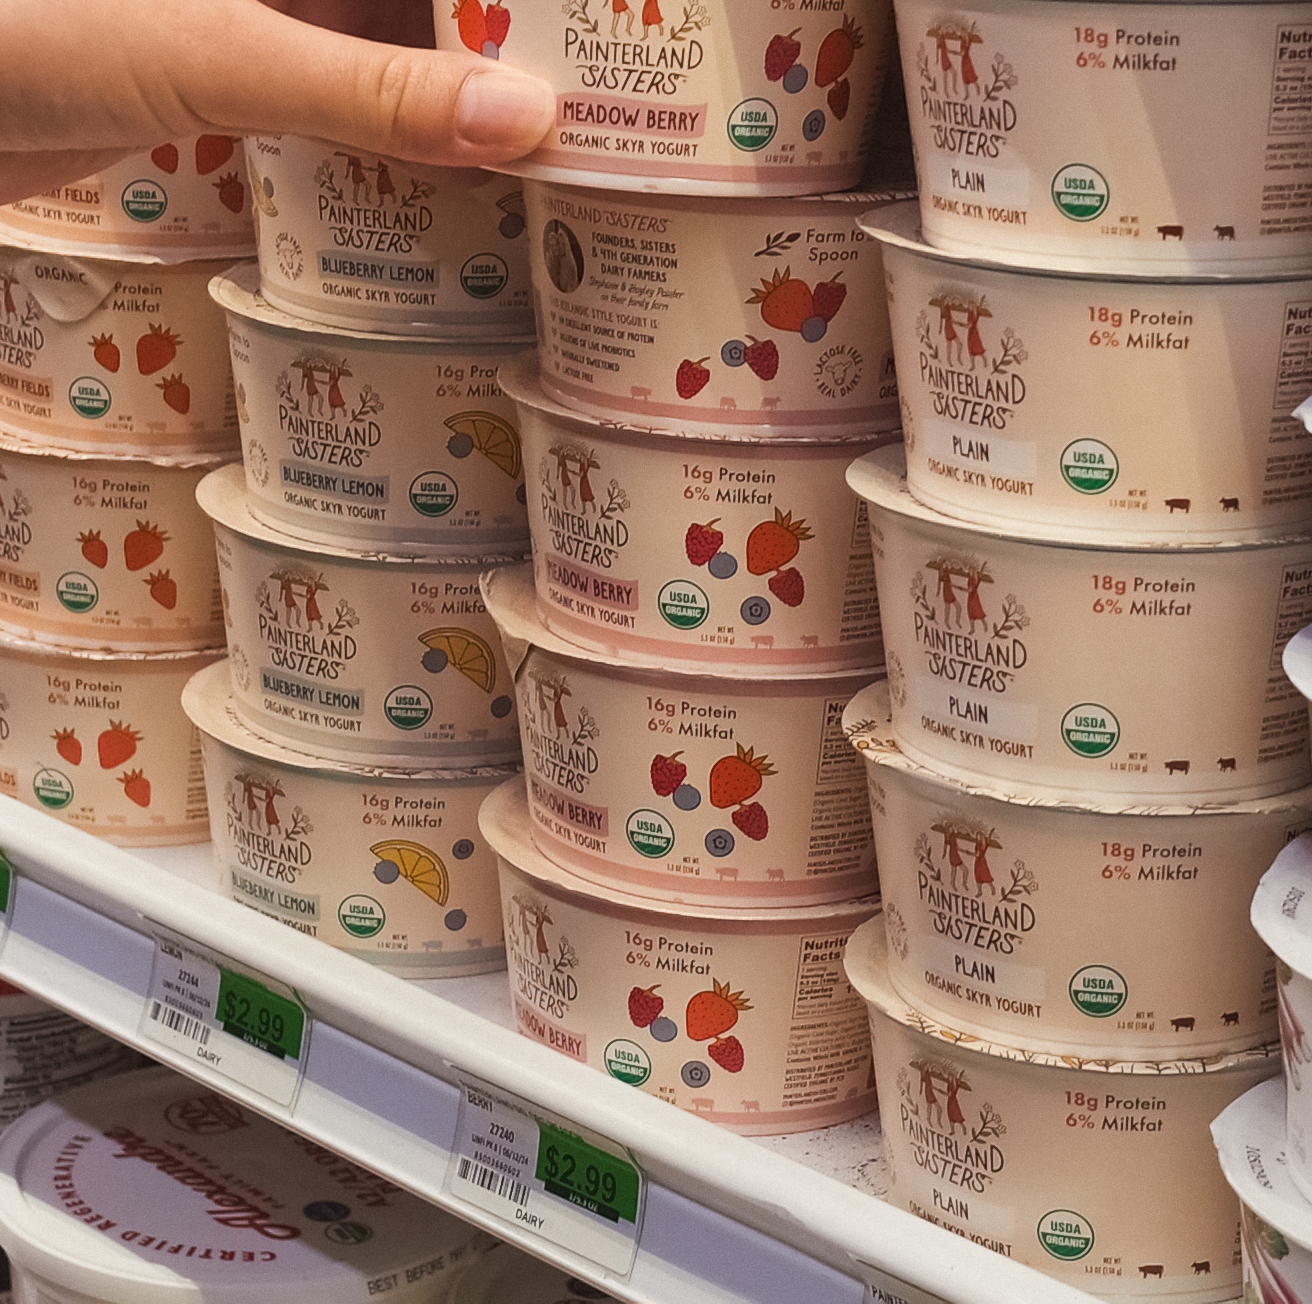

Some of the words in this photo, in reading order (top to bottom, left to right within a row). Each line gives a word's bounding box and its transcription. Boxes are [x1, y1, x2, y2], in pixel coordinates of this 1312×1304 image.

[563, 27, 704, 70] PAINTERLAND
[1074, 26, 1108, 49] 18g
[1116, 30, 1180, 47] Protein
[1076, 52, 1106, 70] 6%
[1112, 53, 1176, 72] Milkfat
[575, 65, 688, 95] SISTERS
[563, 100, 639, 128] MEADOW
[646, 107, 700, 132] BERRY
[741, 110, 768, 124] USDA
[560, 131, 610, 150] ORGANIC
[615, 137, 647, 154] SKYR
[652, 141, 698, 158] YOGURT
[951, 168, 986, 193] PLAIN
[1064, 177, 1095, 191] USDA
[640, 240, 676, 254] SISTERS
[321, 257, 383, 281] BLUEBERRY
[387, 263, 435, 283] LEMON
[620, 252, 677, 269] GENERATION
[600, 263, 625, 277] DAIRY
[628, 268, 667, 283] FARMERS
[75, 678, 123, 694] Protein
[918, 870, 1036, 935] PAINTERLAND
[954, 955, 995, 985] PLAIN
[223, 990, 285, 1043] $2.99
[196, 1047, 222, 1067] DAIRY
[545, 1146, 616, 1203] $2.99
[516, 1209, 544, 1229] DAIRY
